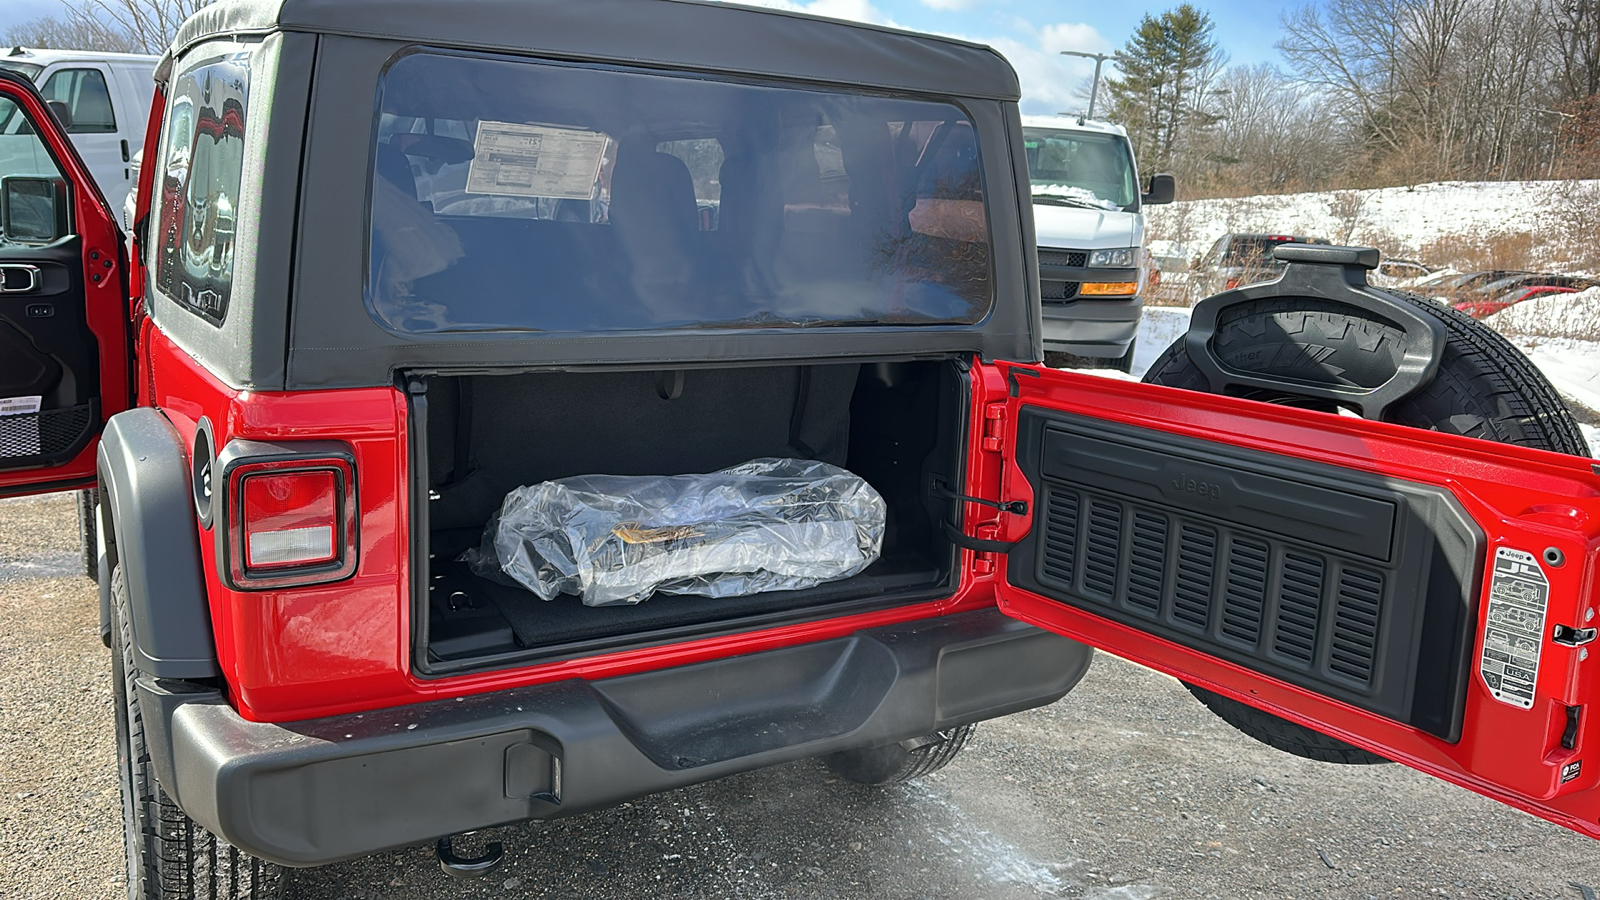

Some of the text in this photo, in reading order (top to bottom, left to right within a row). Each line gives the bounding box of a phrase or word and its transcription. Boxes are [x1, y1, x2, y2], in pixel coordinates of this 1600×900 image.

[1171, 472, 1221, 502] Jeep
[1505, 550, 1524, 560] Jeep
[1496, 562, 1541, 577] JL
